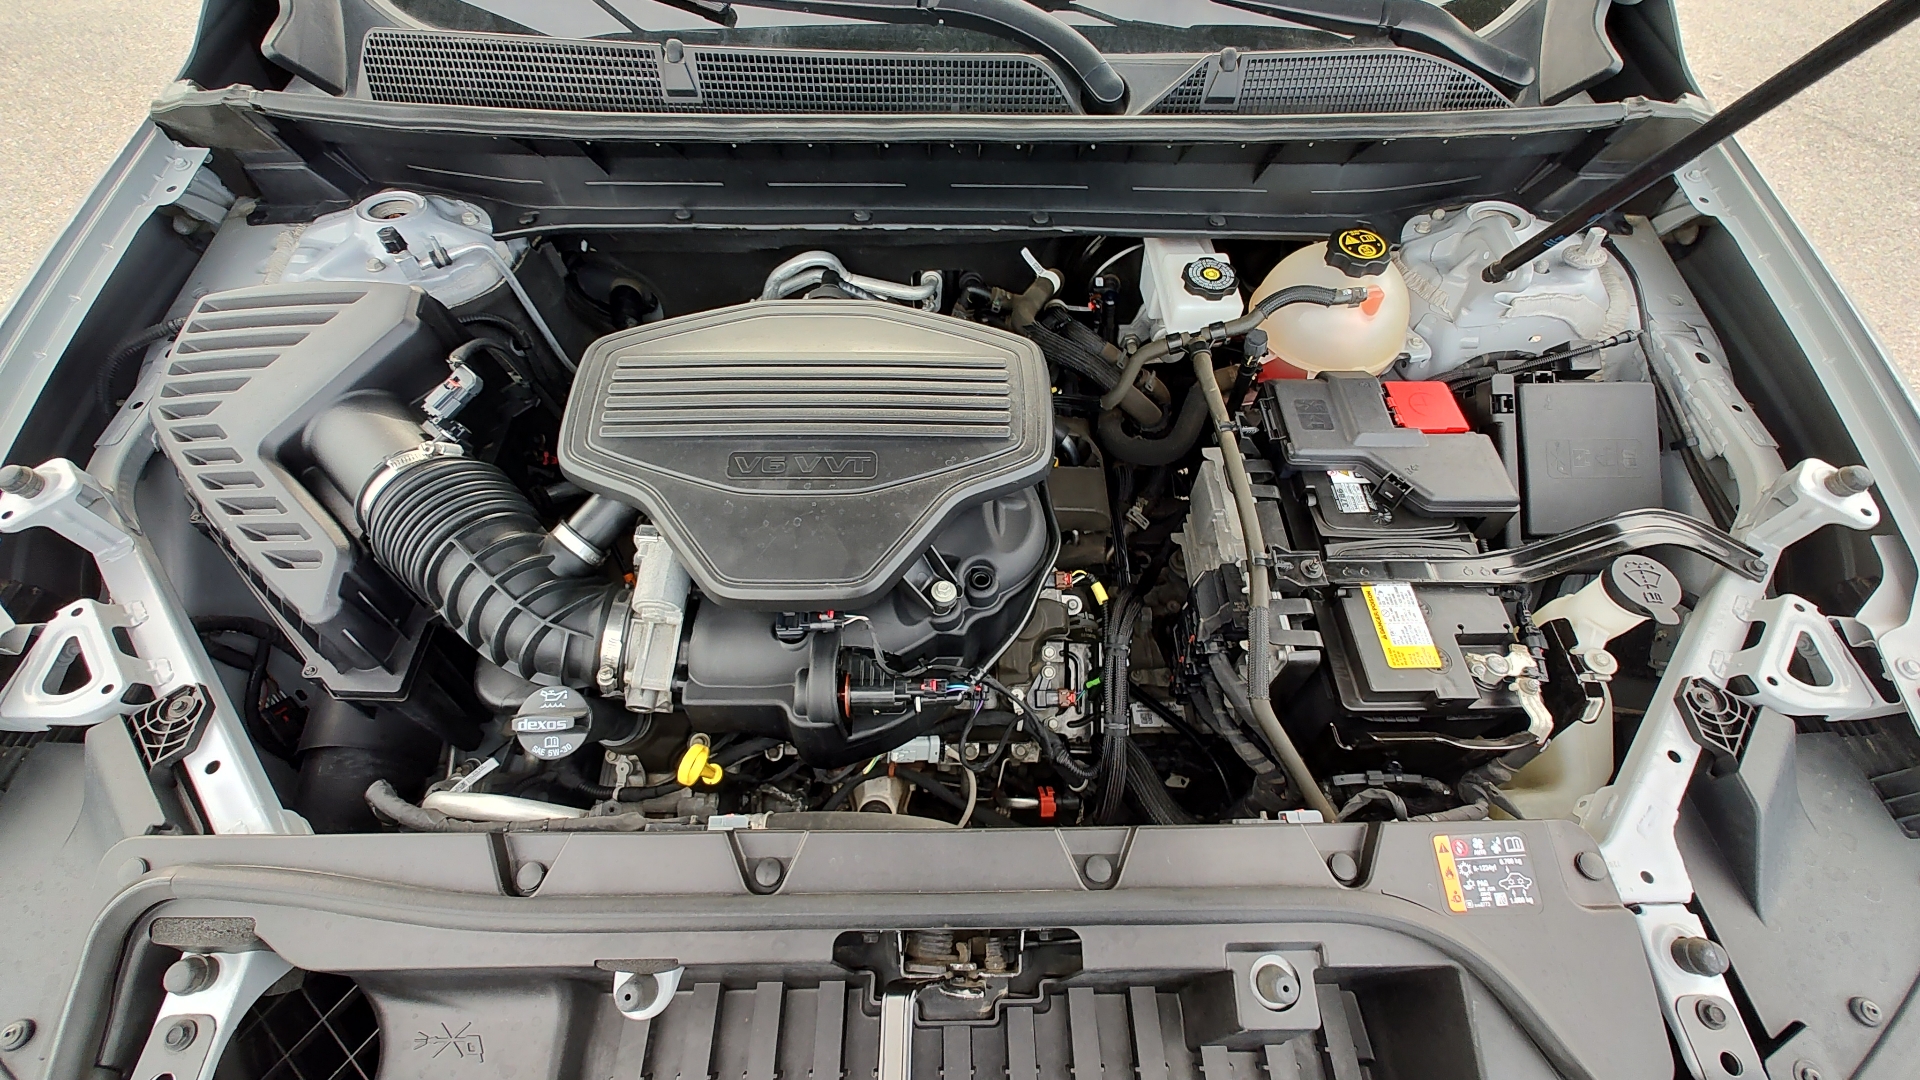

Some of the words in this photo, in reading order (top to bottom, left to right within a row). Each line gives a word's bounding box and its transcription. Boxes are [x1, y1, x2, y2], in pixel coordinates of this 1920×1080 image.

[734, 456, 787, 473] V6
[794, 456, 871, 473] VVT
[517, 719, 567, 730] dexos
[532, 745, 546, 756] SAE
[547, 743, 573, 757] 5W-30
